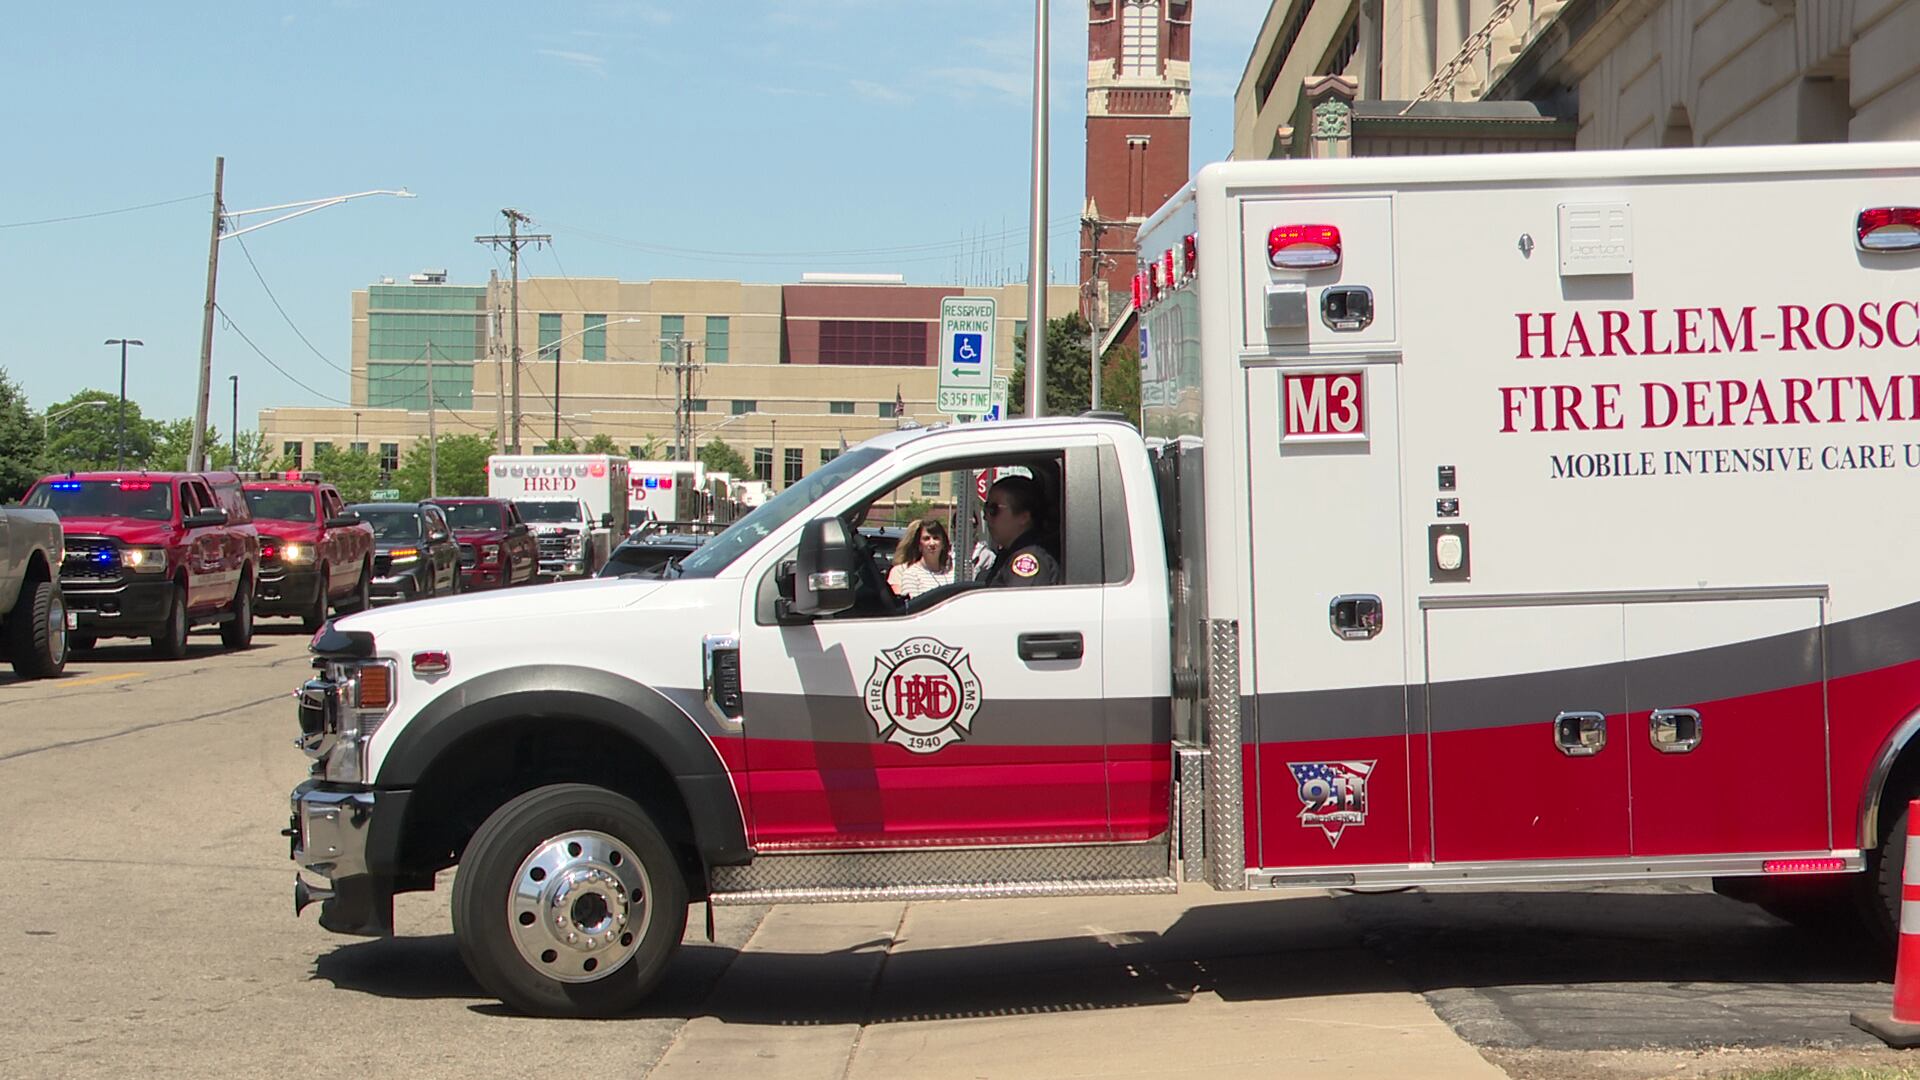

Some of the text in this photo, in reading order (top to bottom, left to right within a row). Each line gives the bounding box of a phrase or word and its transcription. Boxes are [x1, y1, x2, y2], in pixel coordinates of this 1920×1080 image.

[944, 305, 992, 317] RESERVED
[947, 320, 989, 332] PARKING
[1515, 300, 1920, 359] HARLEM-ROSC
[970, 393, 988, 407] FINE
[1288, 376, 1359, 433] M3
[1498, 383, 1625, 433] FIRE
[1550, 452, 1657, 479] MOBILE
[1664, 446, 1814, 476] INTENSIVE
[1821, 444, 1896, 470] CARE
[524, 478, 576, 491] HRFD
[894, 643, 951, 661] RESCUE
[870, 679, 883, 711] FIRE
[964, 680, 976, 711] EMS
[908, 736, 941, 749] 1940
[1302, 778, 1365, 812] 911
